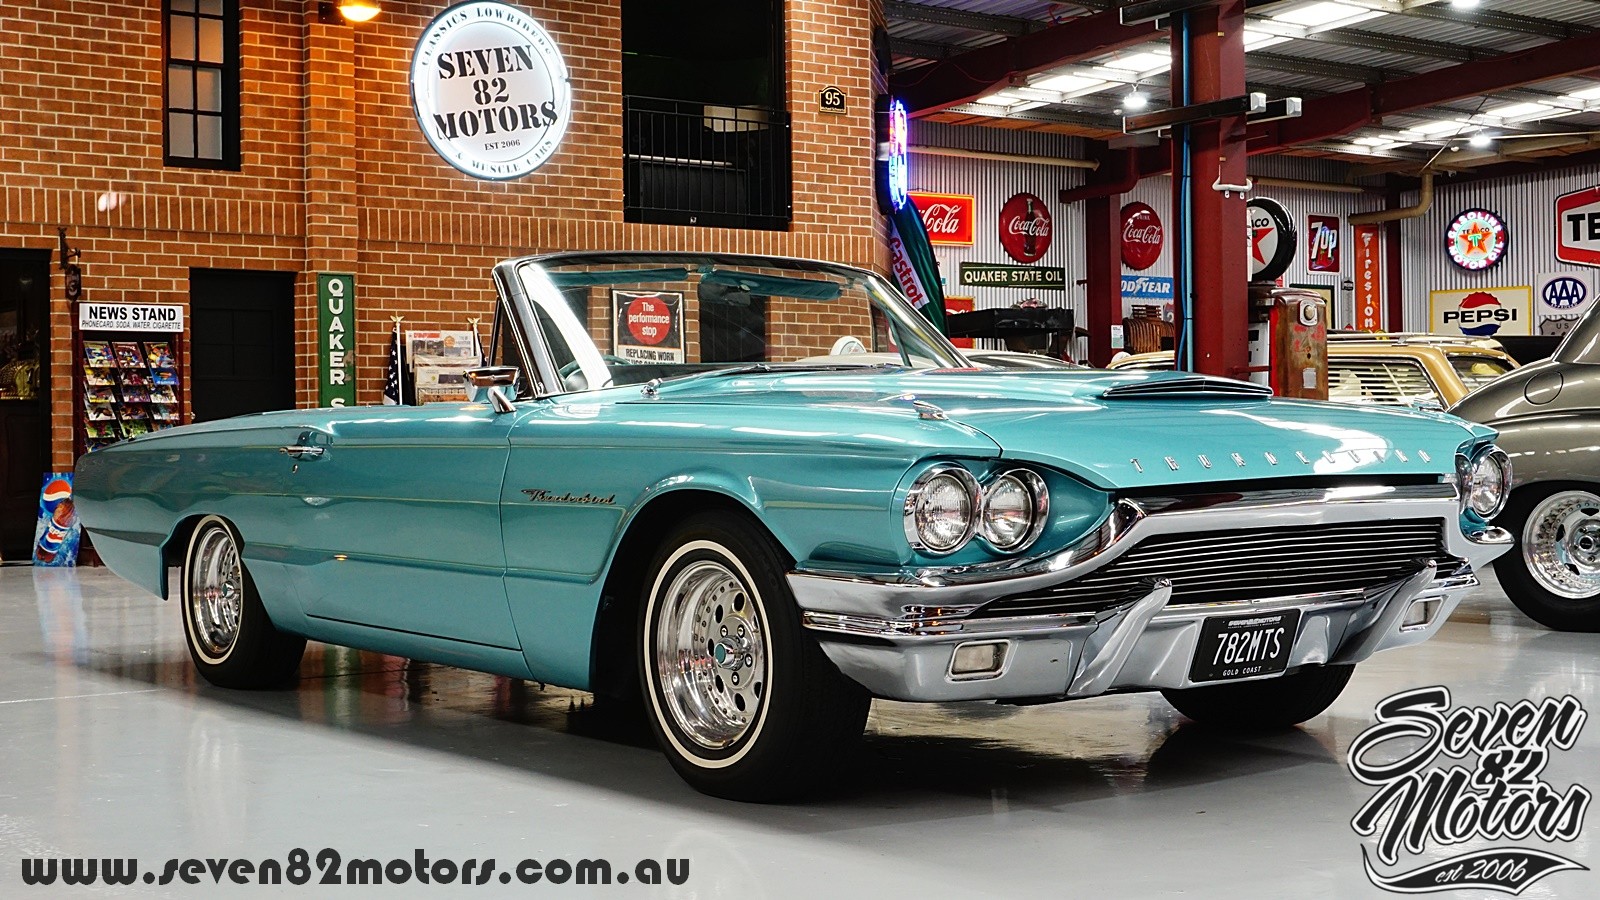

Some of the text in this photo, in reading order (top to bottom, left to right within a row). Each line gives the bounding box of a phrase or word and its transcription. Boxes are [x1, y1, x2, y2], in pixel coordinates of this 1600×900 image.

[422, 10, 468, 66] CLASSICS
[437, 45, 534, 80] SEVEN
[473, 77, 509, 105] 82
[825, 91, 841, 106] 95
[433, 100, 558, 141] MOTORS
[484, 139, 521, 151] EST 2006
[472, 160, 521, 174] MUSCLE
[526, 140, 553, 166] CARS
[1008, 215, 1050, 237] Coca-Cola
[1122, 223, 1161, 245] Coca-Cola
[889, 237, 924, 306] Castrol
[964, 270, 1063, 283] QUAKER STATE OIL
[1548, 279, 1582, 306] AAA
[89, 306, 177, 322] NEWS STAND
[642, 302, 654, 312] The
[1443, 308, 1518, 324] PEPSI
[152, 322, 181, 330] CIGARETTE
[628, 313, 670, 324] performance
[328, 278, 345, 385] QUAKER
[641, 325, 657, 338] stop
[625, 348, 657, 361] REPLACING
[1213, 627, 1284, 665] 782MTS
[1242, 665, 1262, 675] COAST
